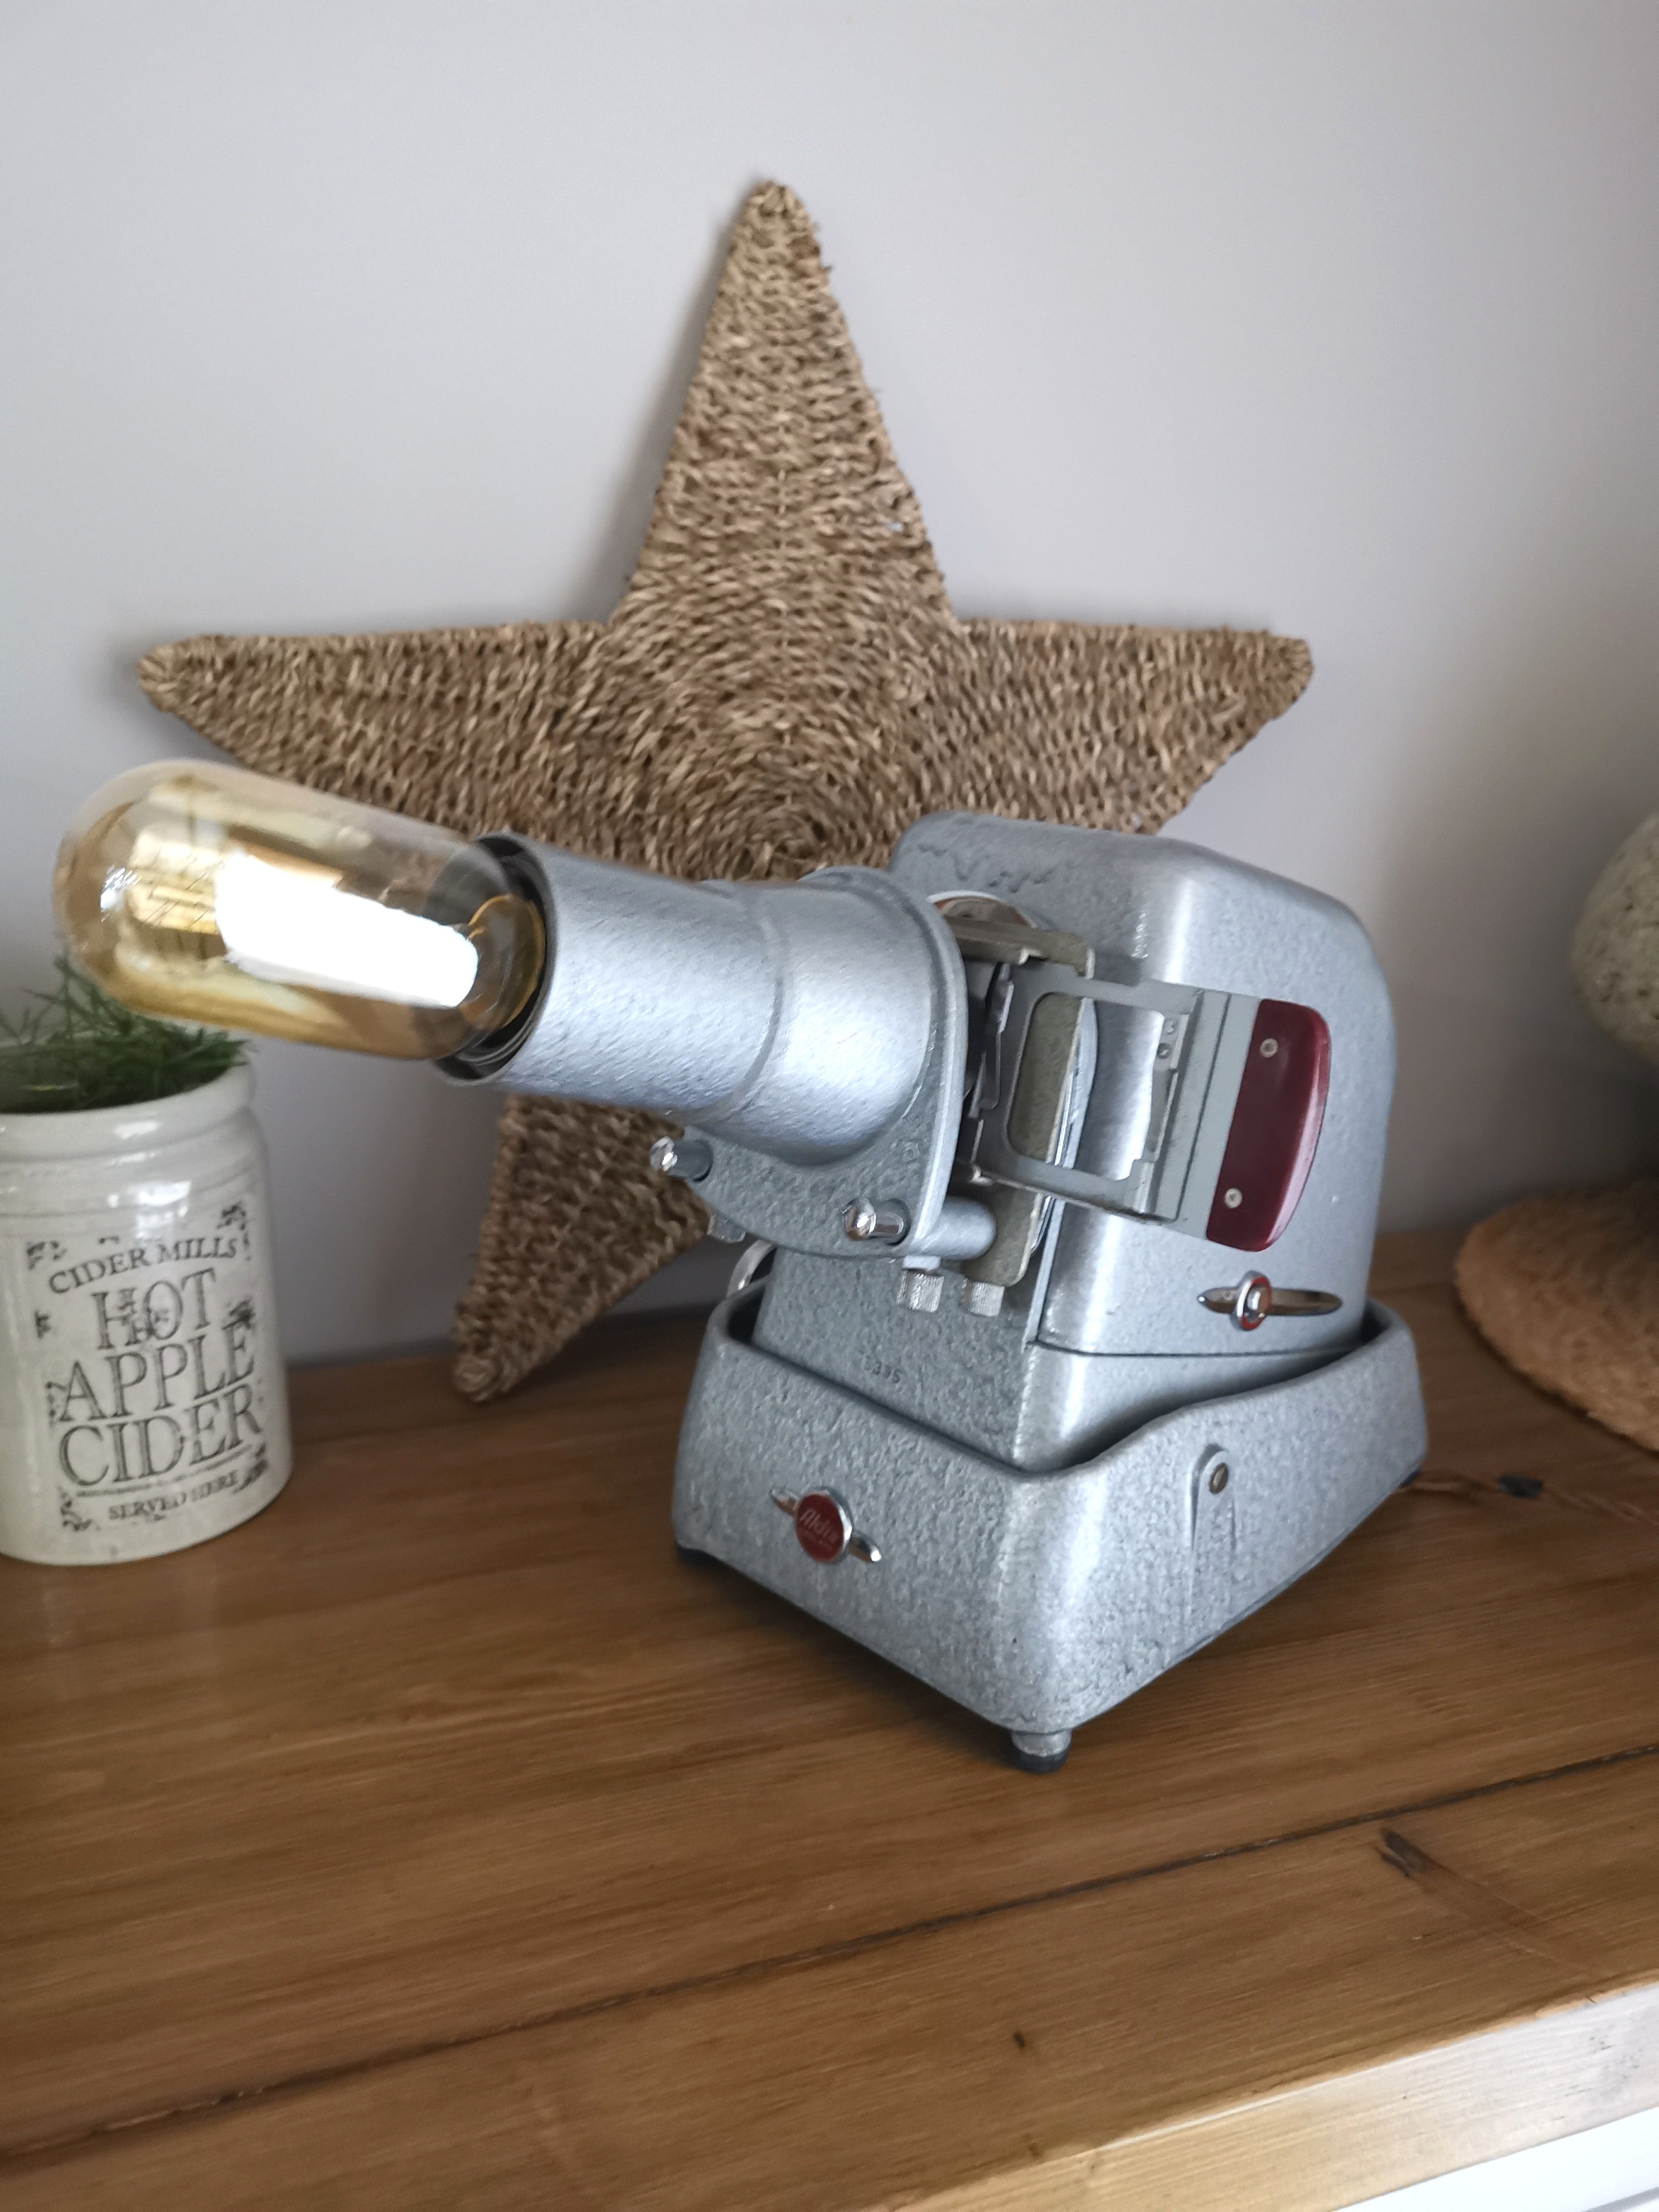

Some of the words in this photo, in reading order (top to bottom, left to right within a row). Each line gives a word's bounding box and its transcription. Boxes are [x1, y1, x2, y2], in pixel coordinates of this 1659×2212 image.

[48, 1247, 152, 1295] CIDER
[156, 1236, 238, 1264] MILLS
[91, 1267, 215, 1350] HOT
[59, 1323, 256, 1422] APPLE
[59, 1383, 264, 1487] CIDER
[108, 1491, 187, 1521] SERVED
